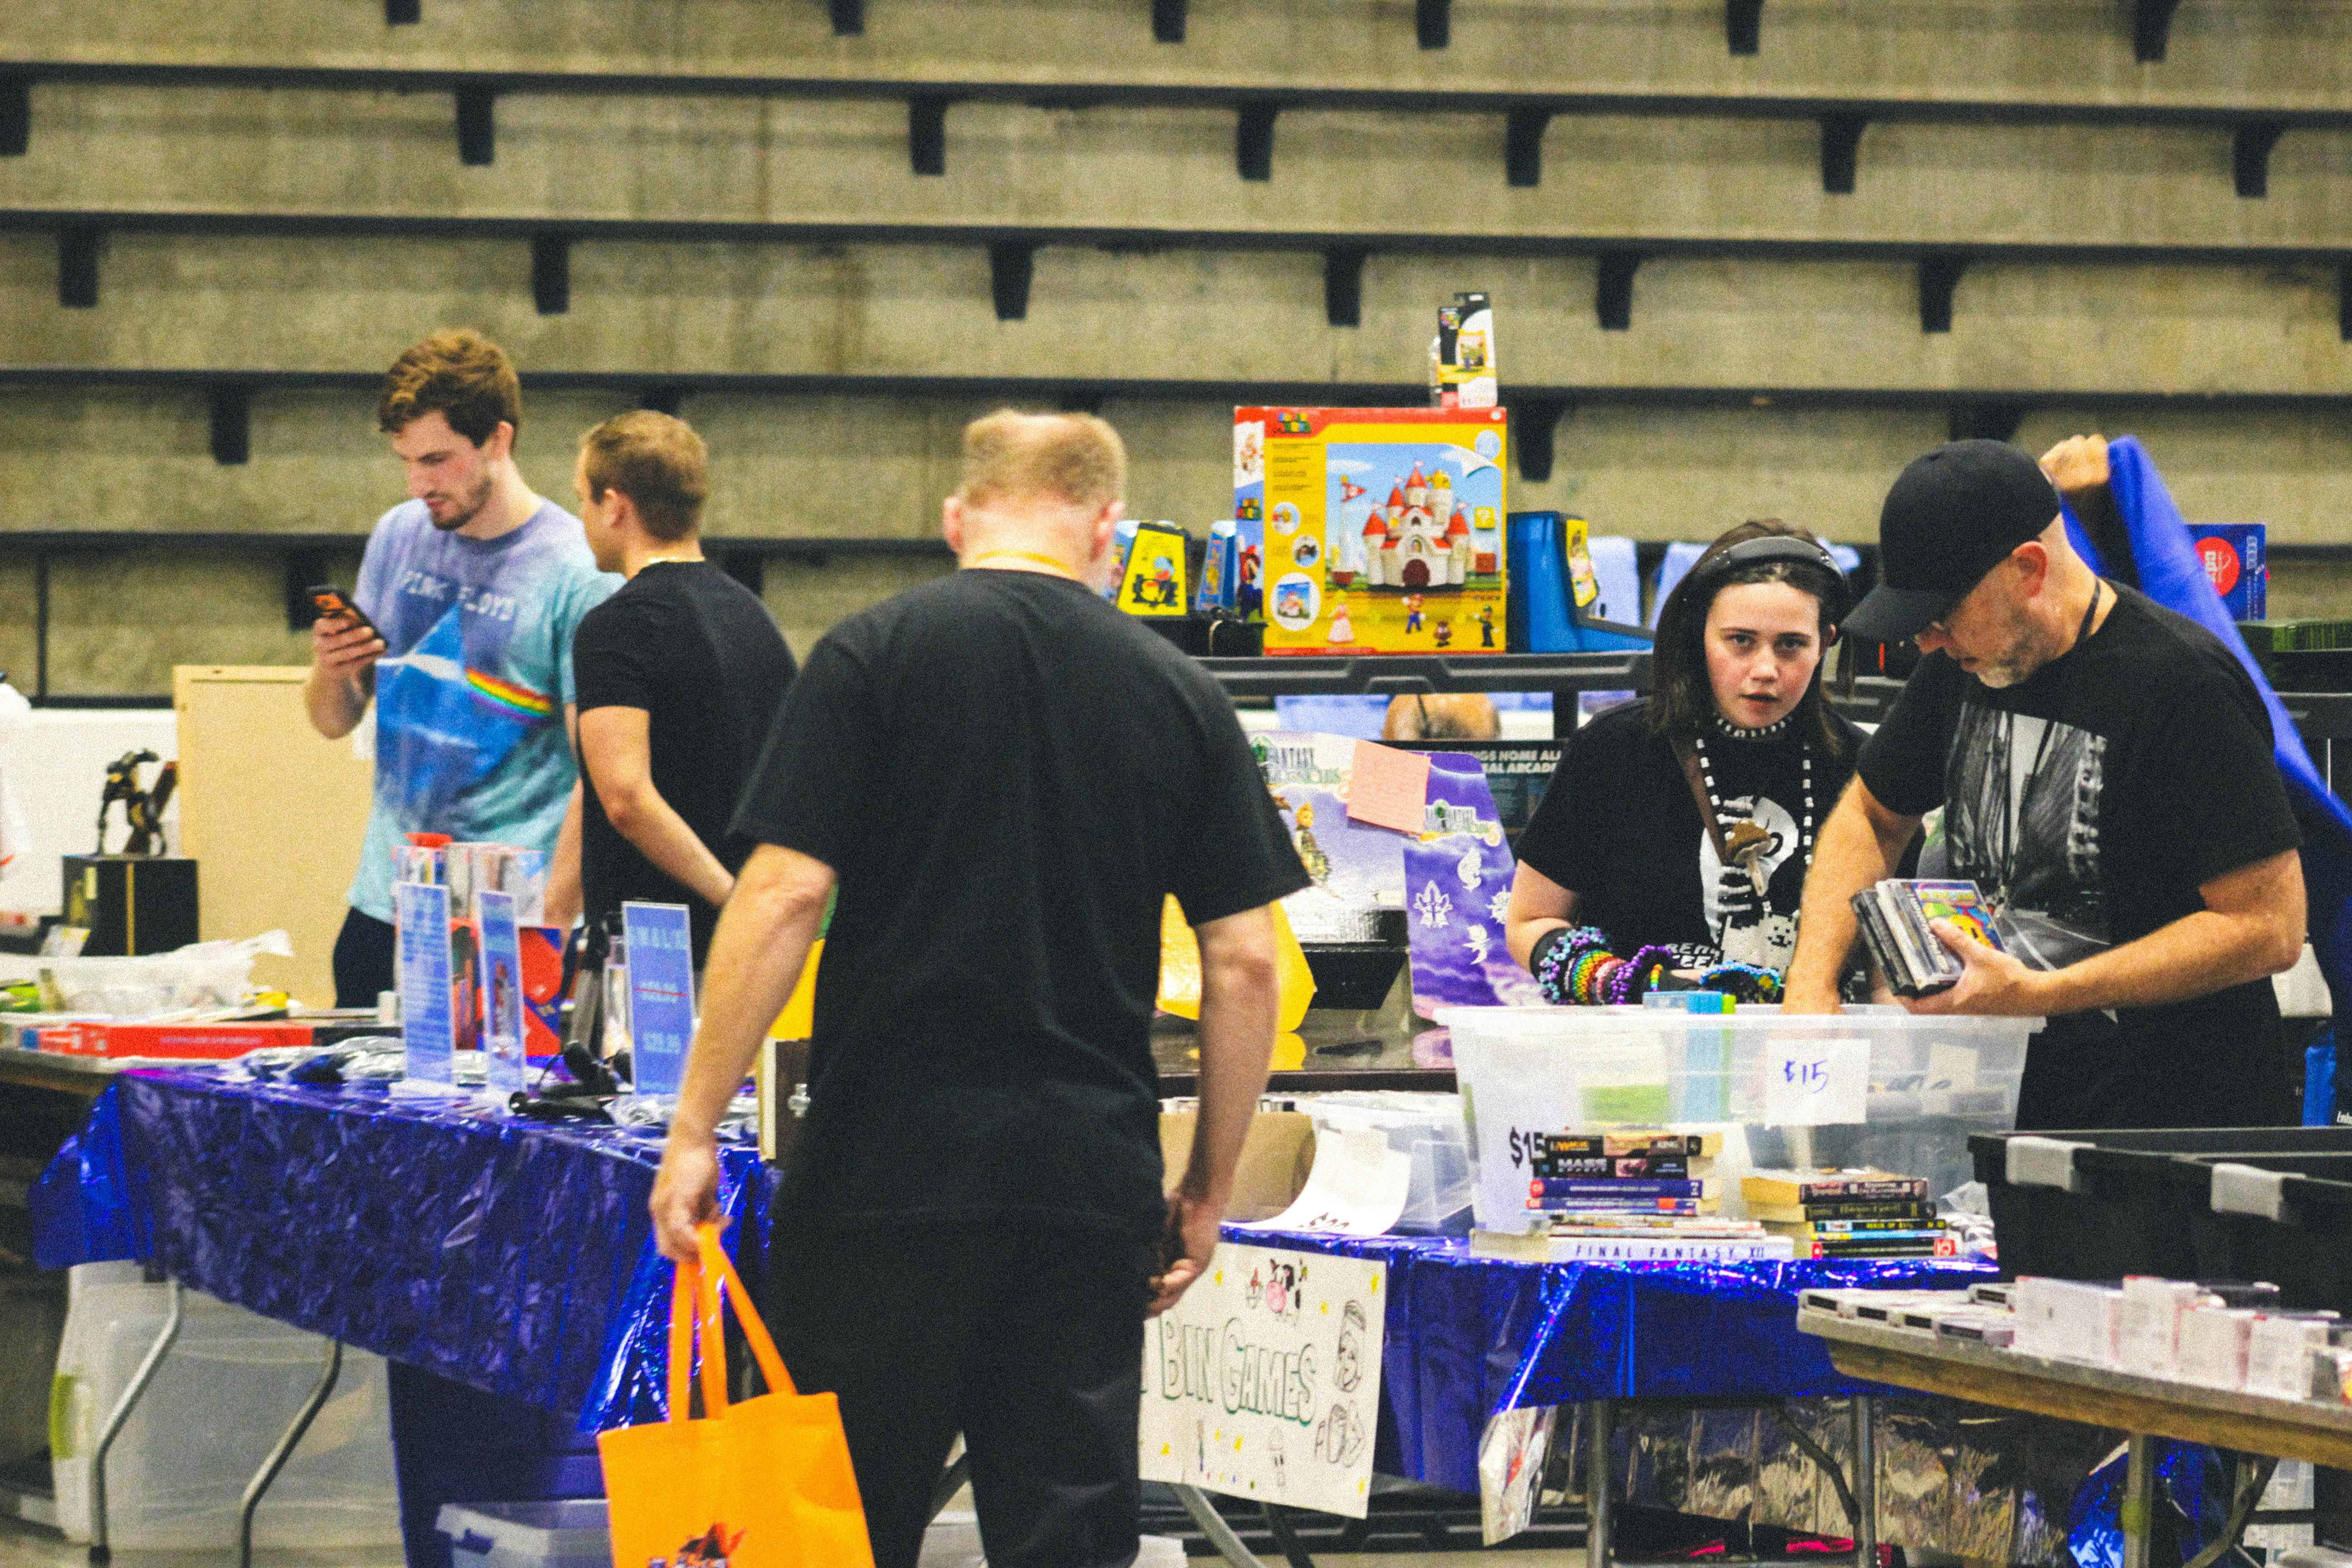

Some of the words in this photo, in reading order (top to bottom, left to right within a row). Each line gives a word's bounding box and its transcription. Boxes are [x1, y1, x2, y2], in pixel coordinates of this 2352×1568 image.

[1499, 750, 1538, 761] HOME
[1576, 1245, 1632, 1258] FINAL
[1649, 1246, 1735, 1259] FANTASY
